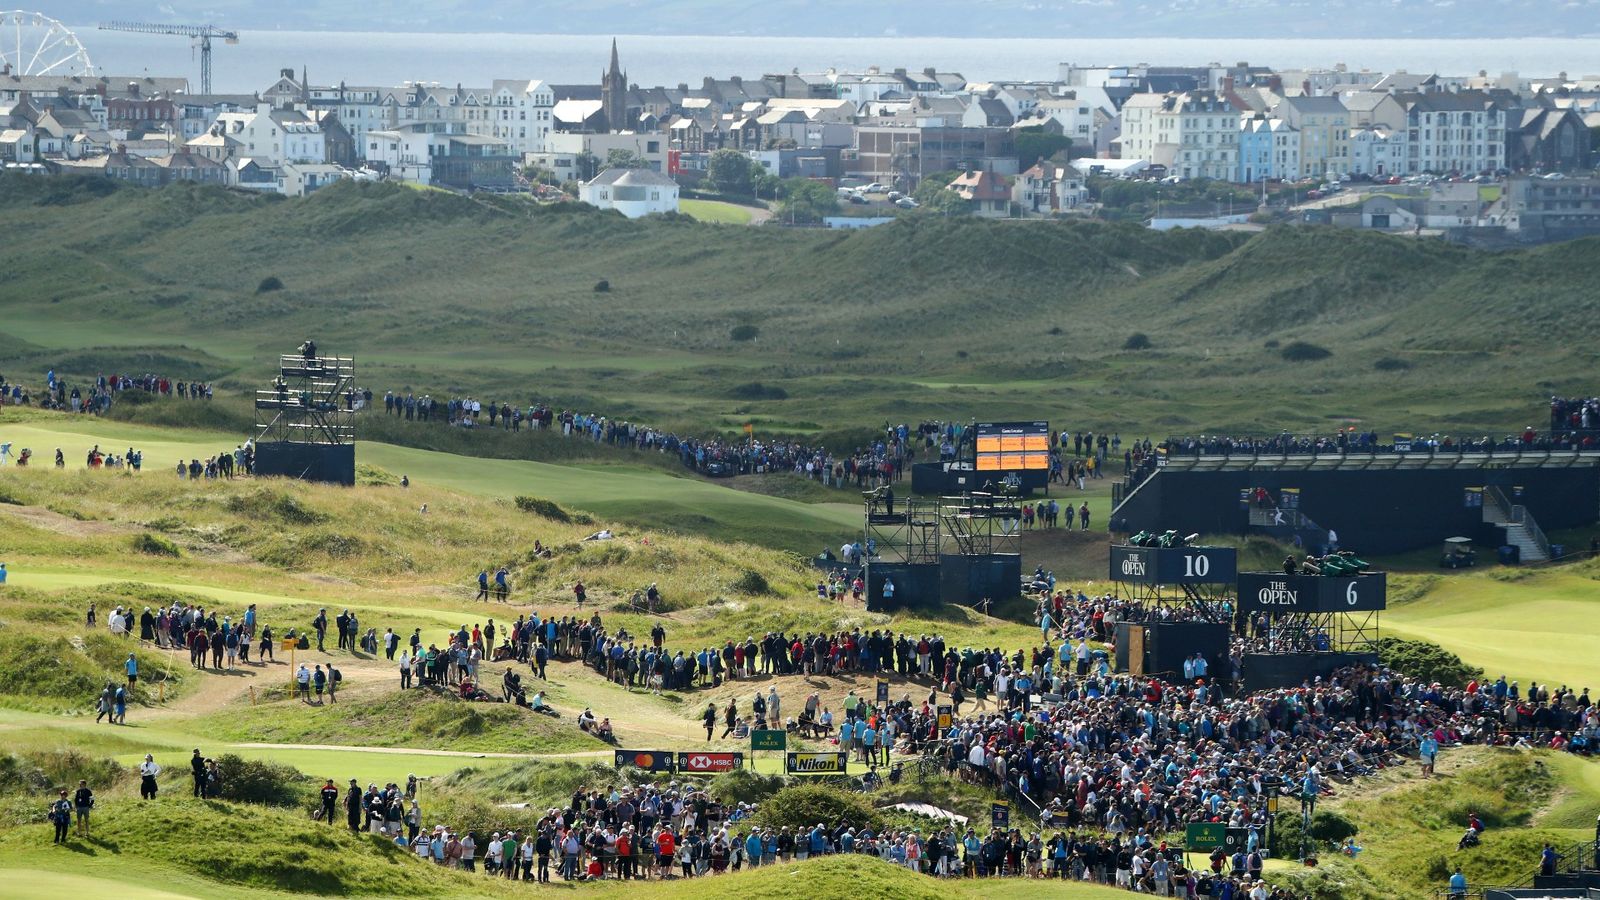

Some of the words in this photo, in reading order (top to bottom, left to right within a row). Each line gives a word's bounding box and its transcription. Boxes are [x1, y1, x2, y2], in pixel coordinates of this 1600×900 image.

[1128, 553, 1139, 561] THE
[1121, 560, 1146, 576] OPEN
[1184, 554, 1209, 577] 10
[1269, 581, 1287, 590] THE
[1346, 581, 1358, 605] 6
[1258, 588, 1298, 605] OPEN
[798, 758, 835, 770] Nikon
